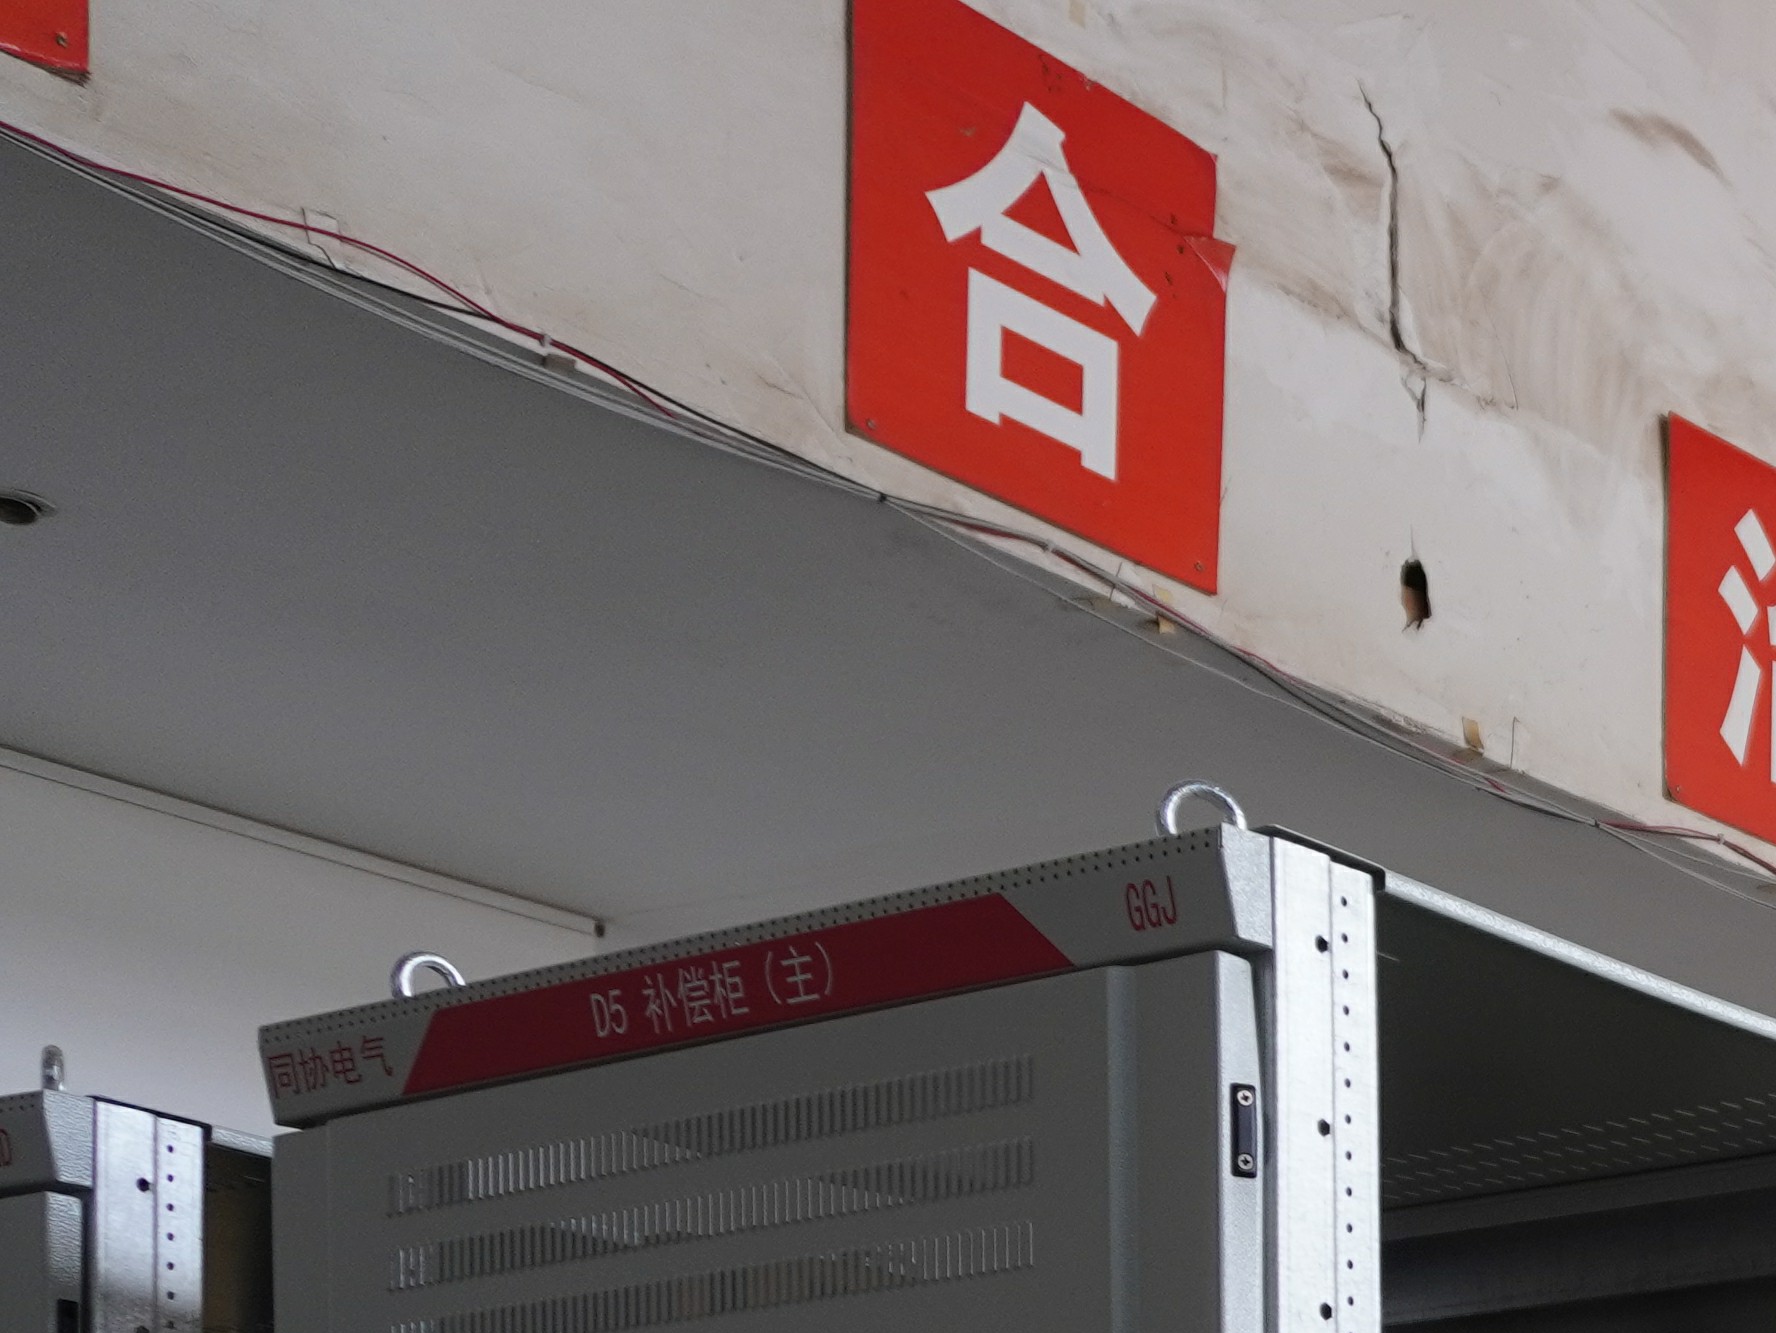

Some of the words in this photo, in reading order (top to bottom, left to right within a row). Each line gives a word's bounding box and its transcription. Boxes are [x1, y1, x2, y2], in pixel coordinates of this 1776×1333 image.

[927, 102, 1158, 482] 合
[266, 1035, 396, 1098] 同协电气
[589, 988, 629, 1038] D5
[1123, 878, 1180, 934] GGJ
